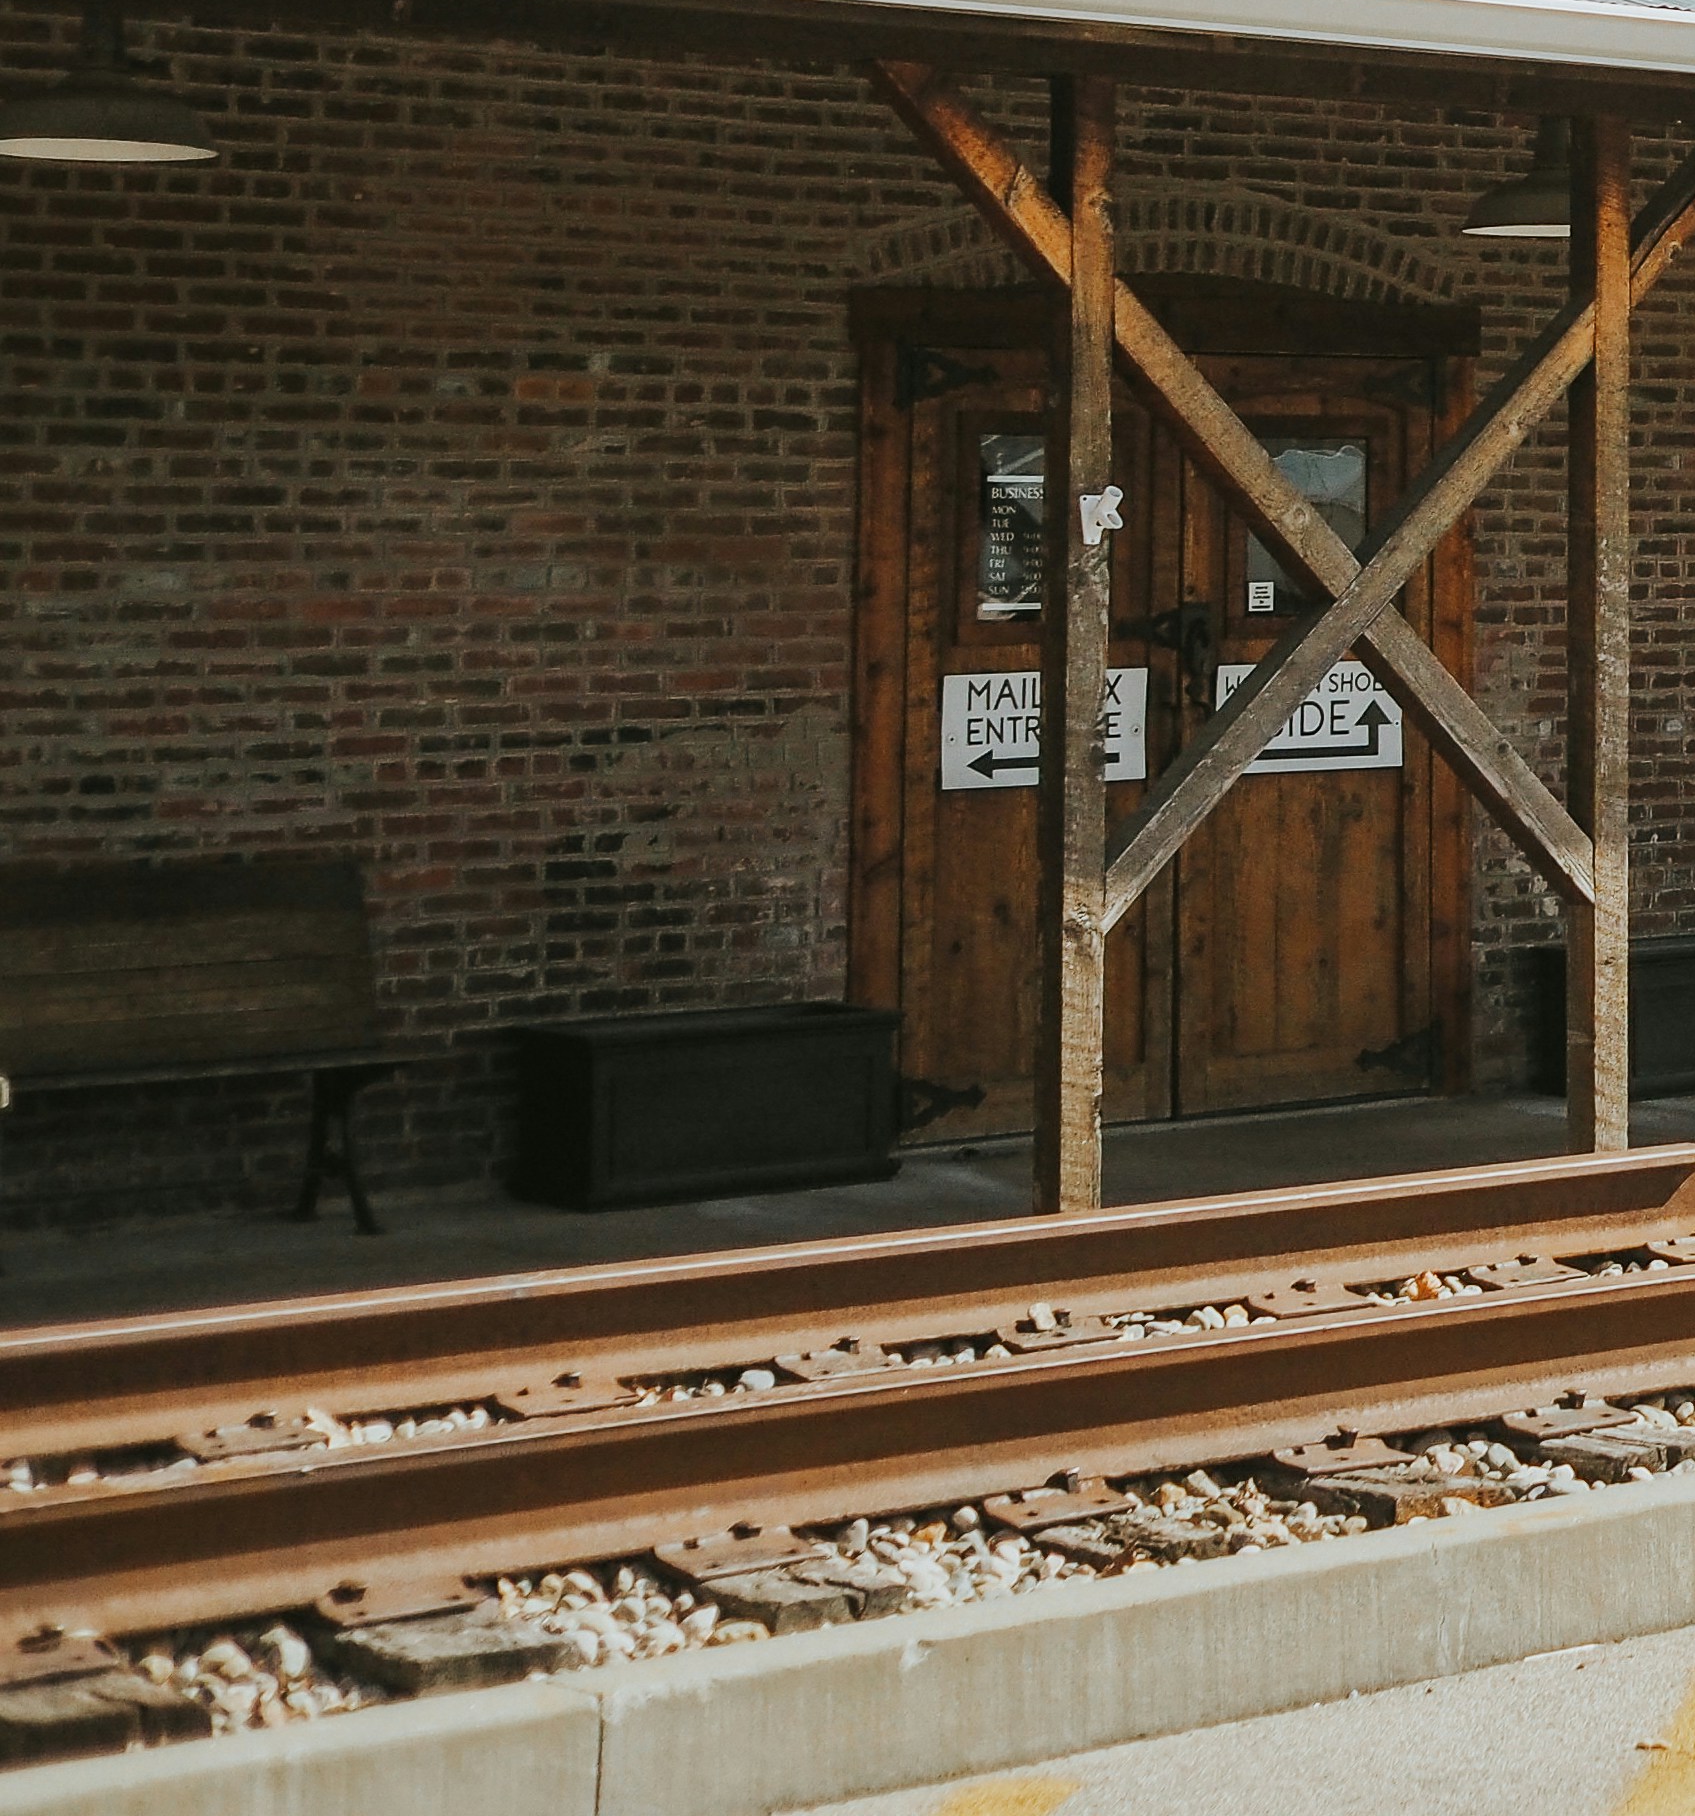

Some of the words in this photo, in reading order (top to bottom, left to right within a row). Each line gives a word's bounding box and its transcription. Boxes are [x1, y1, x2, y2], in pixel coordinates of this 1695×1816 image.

[991, 505, 1016, 515] MON
[992, 518, 1010, 528] TUE
[989, 532, 1015, 542] WED
[990, 544, 1012, 555] THU
[988, 557, 1006, 568] FRI
[988, 571, 1006, 582] SAT
[988, 585, 1010, 595] SUN
